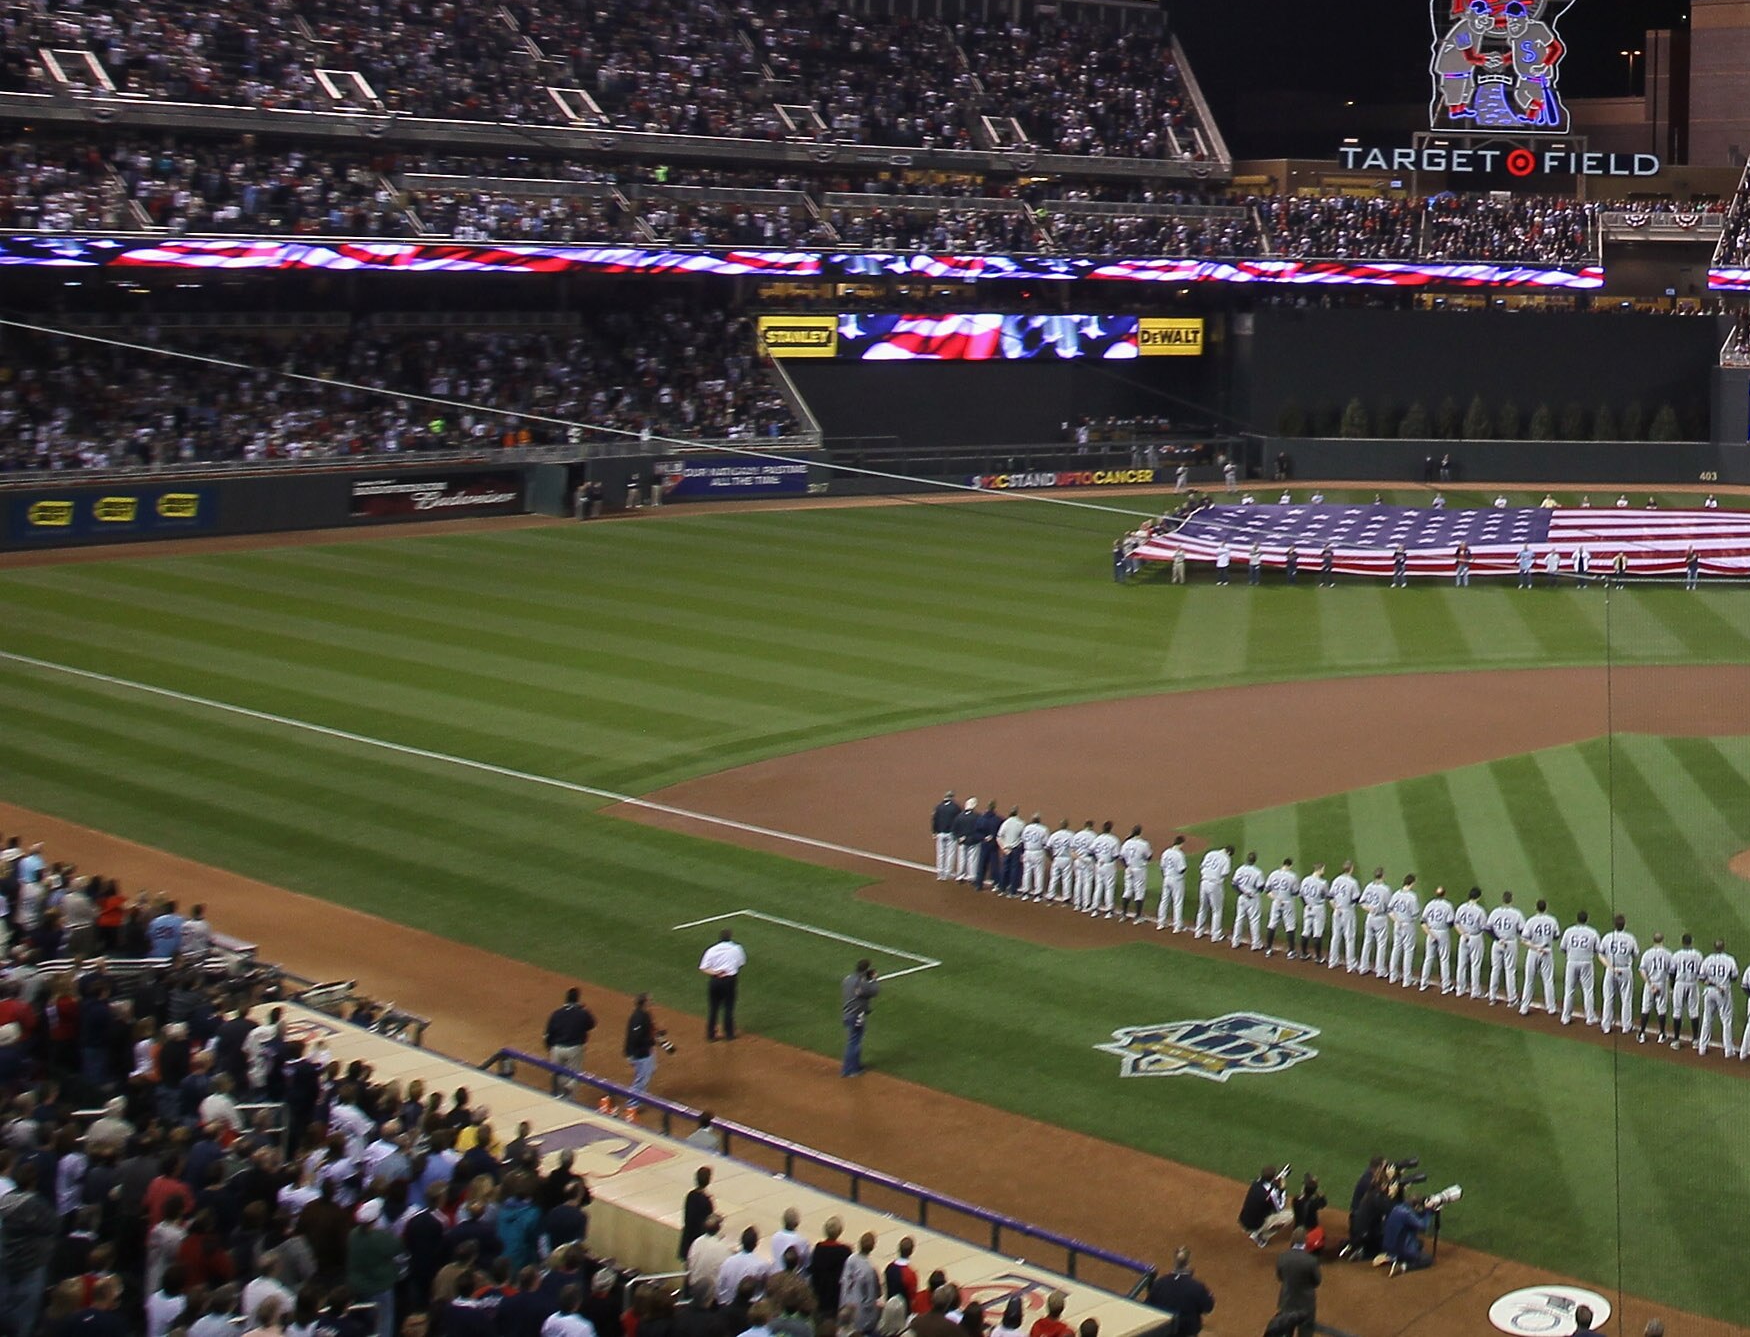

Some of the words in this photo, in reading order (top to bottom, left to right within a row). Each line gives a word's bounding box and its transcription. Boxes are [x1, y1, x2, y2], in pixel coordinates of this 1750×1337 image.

[1339, 147, 1500, 173] TARGET
[1544, 151, 1661, 177] FIELD
[1699, 471, 1717, 481] 403
[1534, 924, 1552, 937] 48
[1570, 934, 1589, 949] 62
[1610, 940, 1628, 955] 65
[1652, 956, 1664, 971] 11
[1683, 959, 1695, 974] 14
